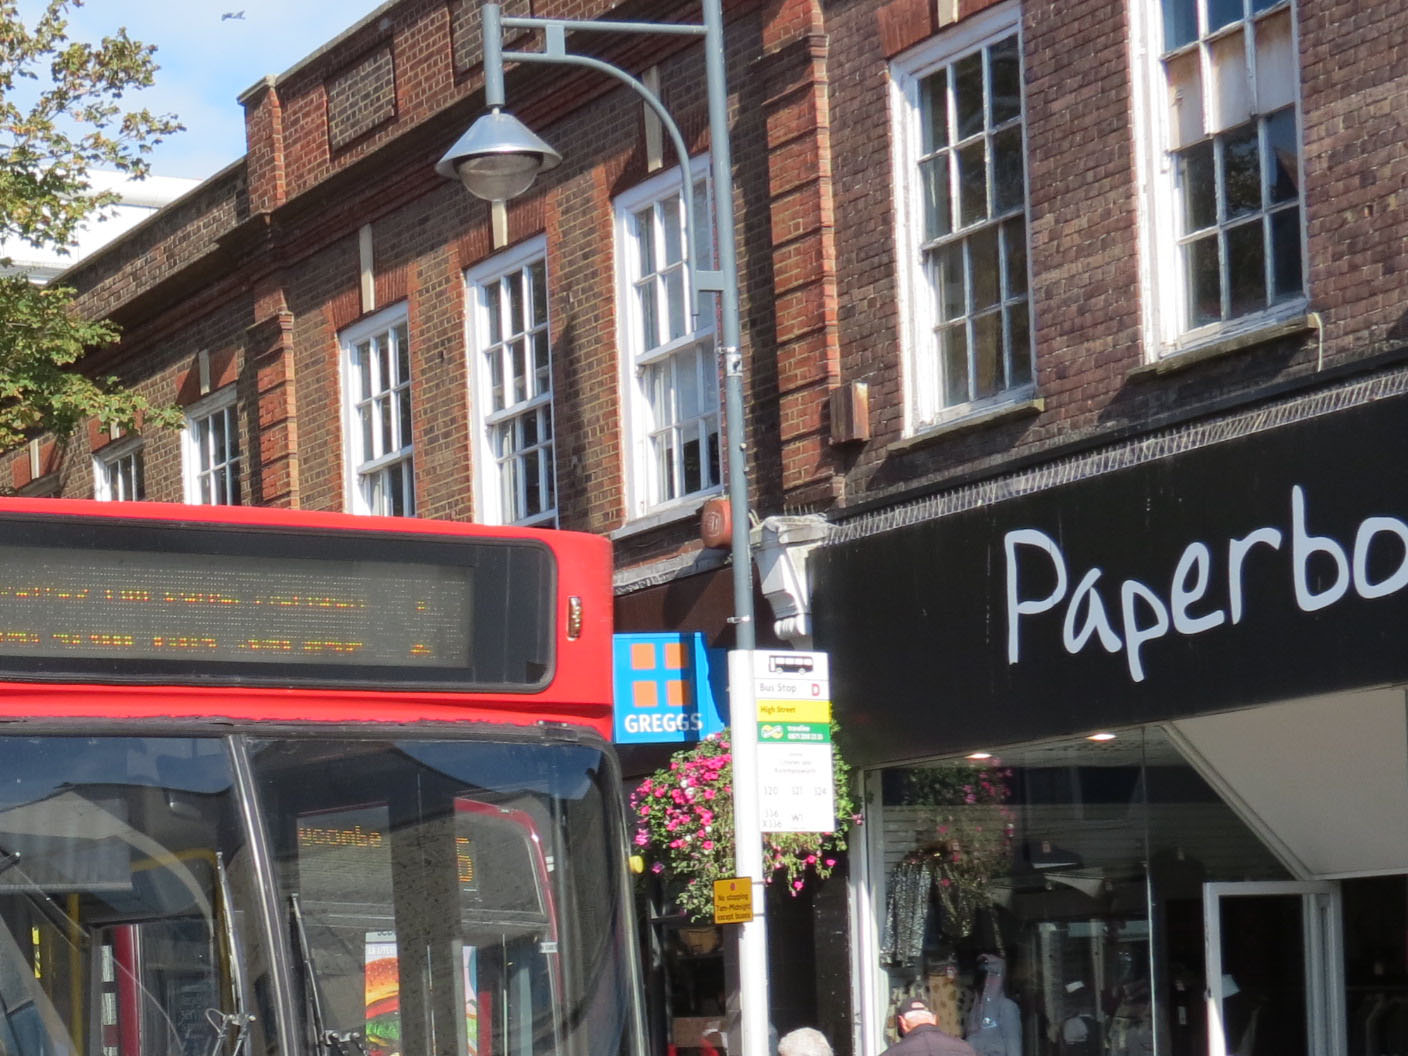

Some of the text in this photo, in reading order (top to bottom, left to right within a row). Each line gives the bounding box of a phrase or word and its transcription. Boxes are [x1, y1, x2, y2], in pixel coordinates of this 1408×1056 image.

[1004, 485, 1408, 682] Paperbo
[759, 683, 821, 696] Bus Stop D
[760, 706, 775, 715] High
[624, 713, 703, 733] GREGGS
